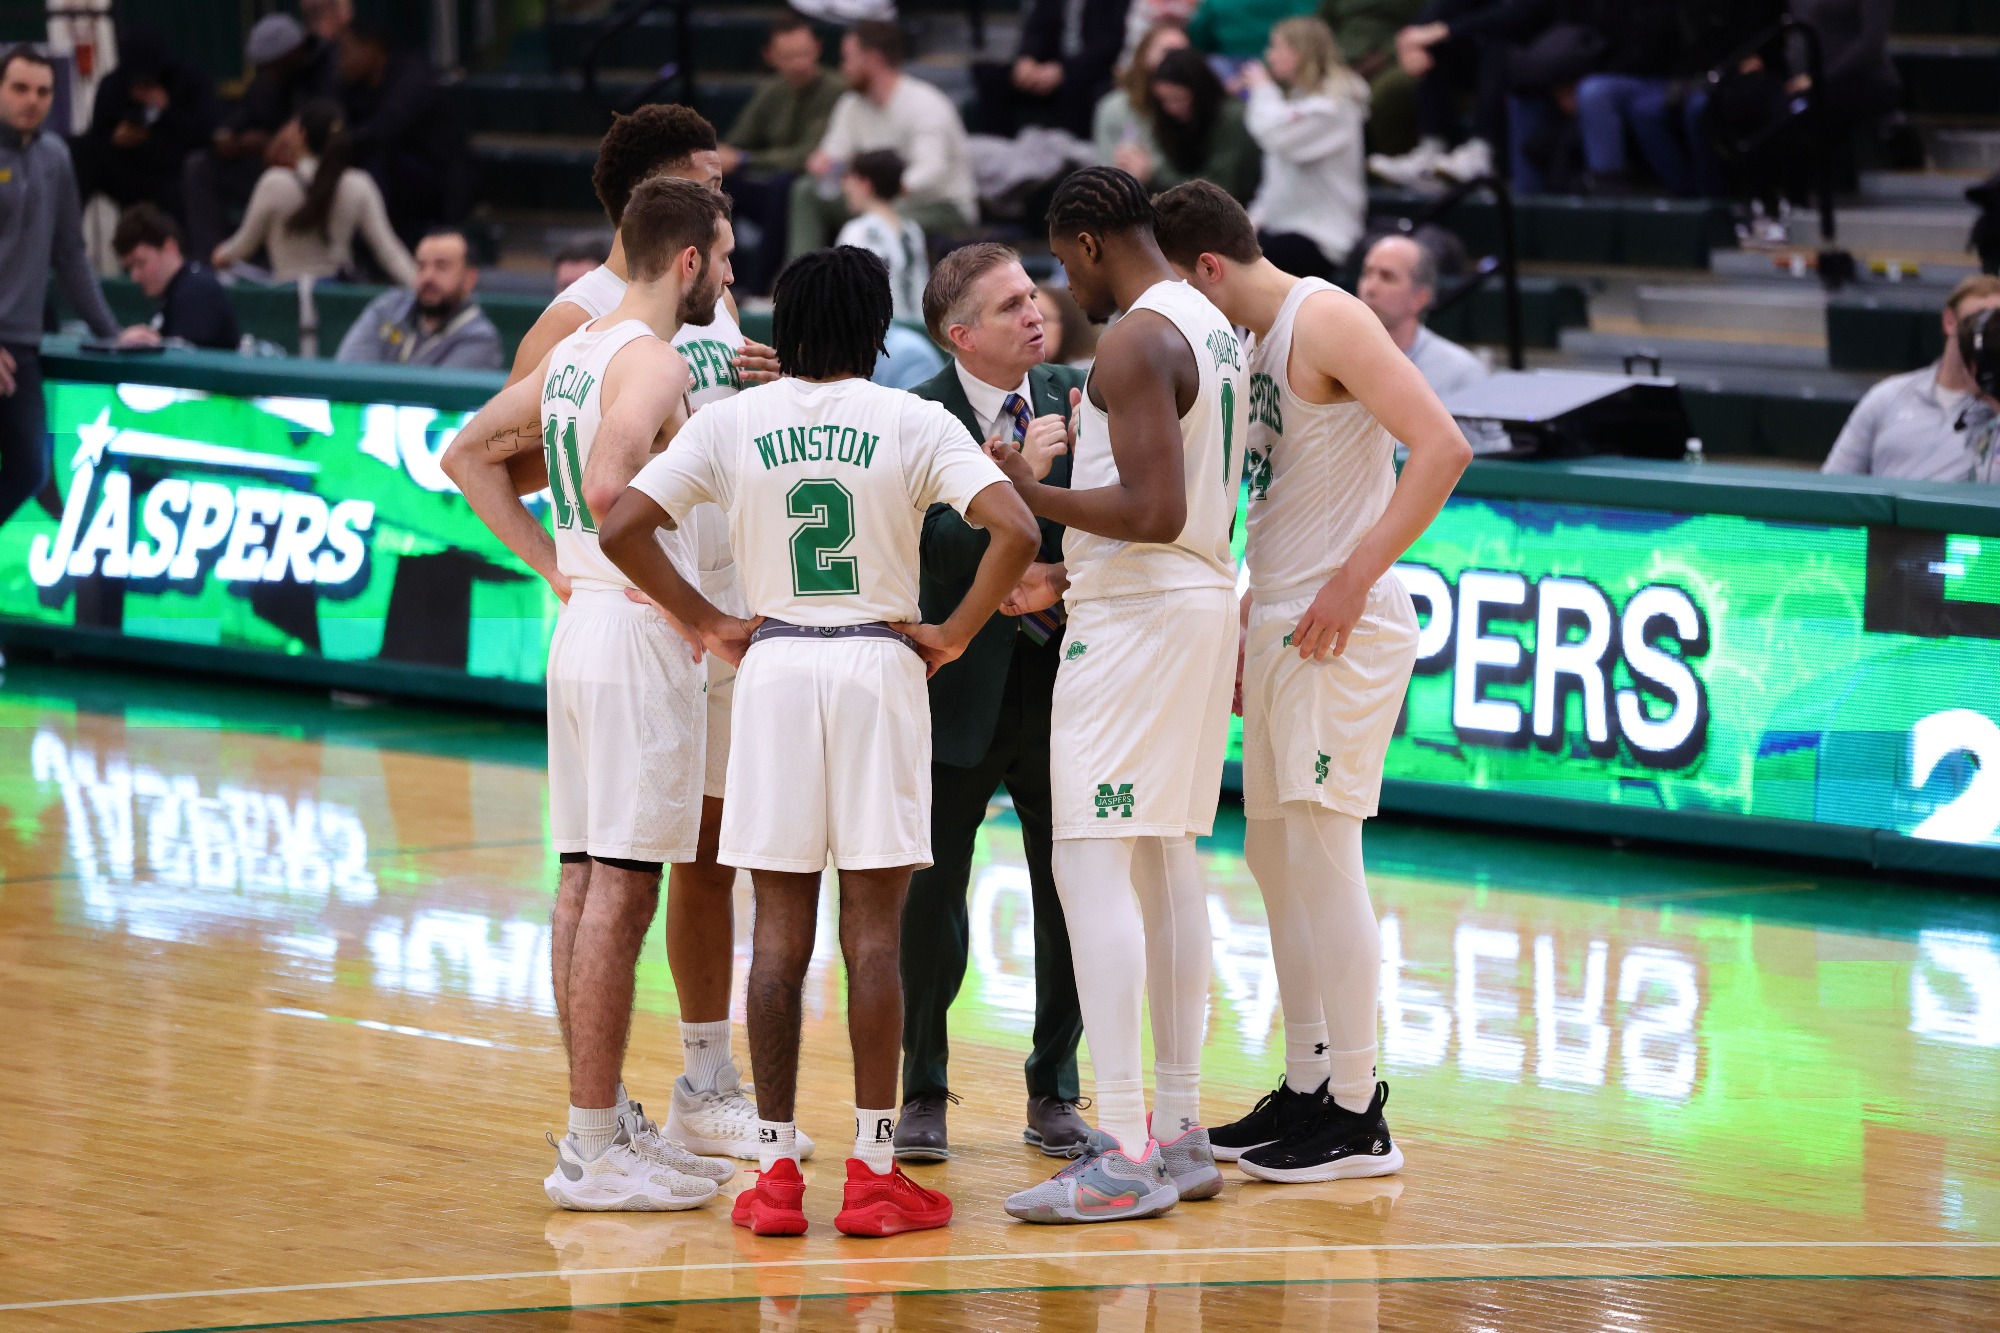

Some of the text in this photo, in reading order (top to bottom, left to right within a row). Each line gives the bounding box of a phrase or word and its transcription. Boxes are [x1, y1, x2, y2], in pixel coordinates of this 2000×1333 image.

[544, 413, 599, 534] 11
[753, 424, 880, 470] WINSTON
[28, 460, 375, 587] JASPERS
[786, 478, 859, 596] 2
[1097, 795, 1132, 806] JASPERS
